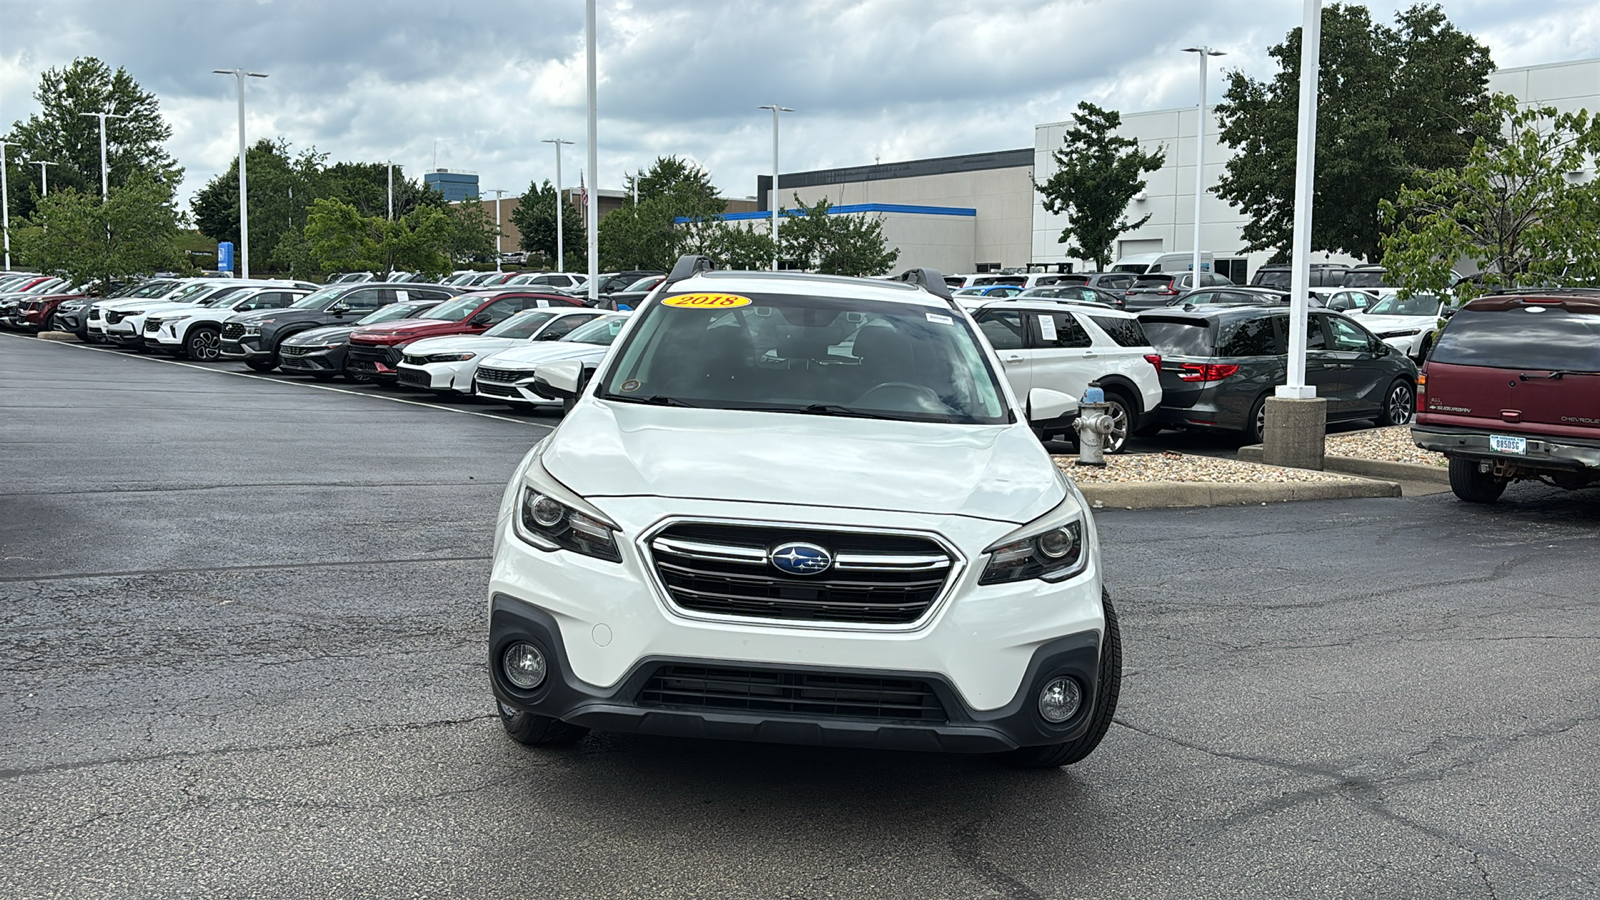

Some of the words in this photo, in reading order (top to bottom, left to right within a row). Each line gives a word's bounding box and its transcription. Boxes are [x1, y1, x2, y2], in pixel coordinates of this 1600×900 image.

[675, 296, 738, 305] 2018
[1437, 405, 1472, 413] SUBURBAN
[1561, 416, 1600, 424] CHEVROLE
